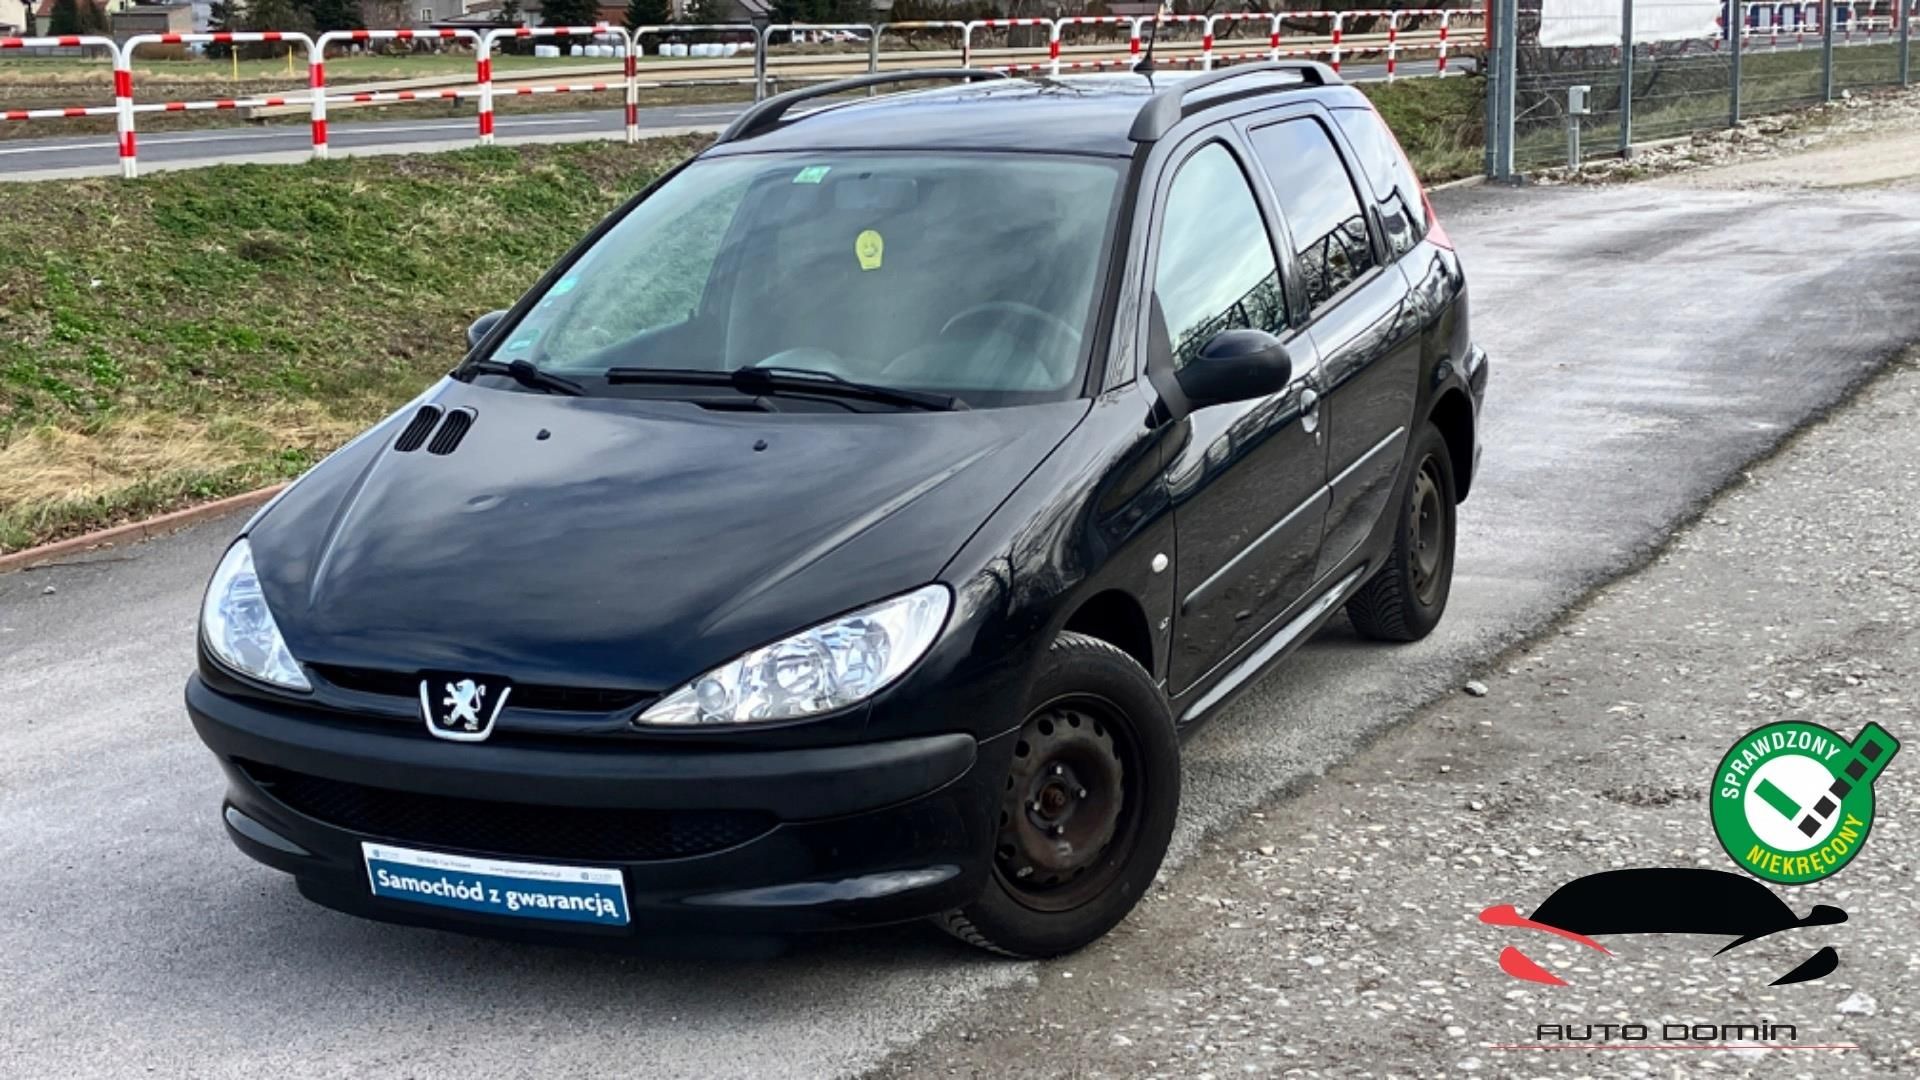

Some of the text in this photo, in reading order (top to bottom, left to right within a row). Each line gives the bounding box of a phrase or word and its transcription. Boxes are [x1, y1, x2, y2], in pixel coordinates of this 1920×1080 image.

[376, 868, 484, 902] Samochód
[489, 888, 501, 904] z
[506, 889, 620, 918] gwarancją
